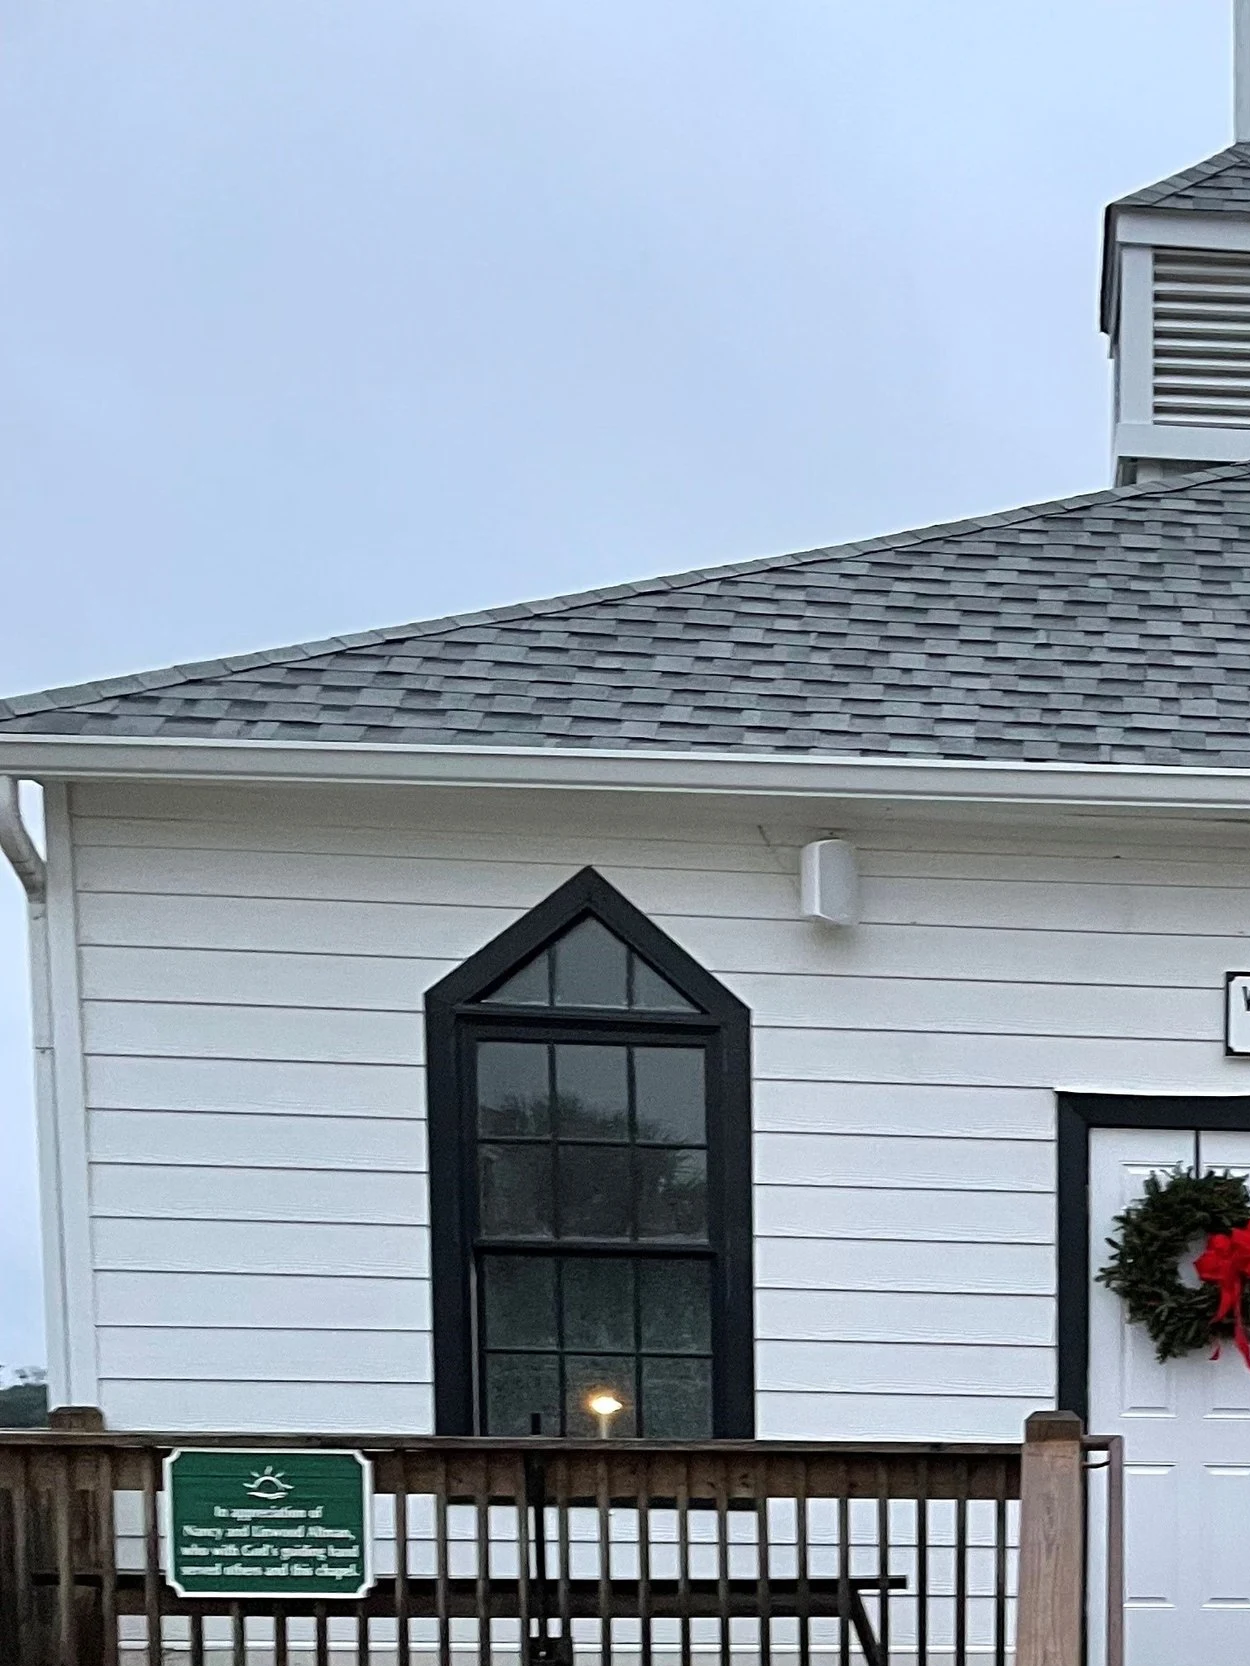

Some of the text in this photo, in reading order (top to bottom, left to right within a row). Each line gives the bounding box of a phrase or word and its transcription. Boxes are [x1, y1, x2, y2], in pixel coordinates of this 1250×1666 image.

[213, 1505, 324, 1521] In appreciation of
[182, 1525, 223, 1540] Nancy
[224, 1525, 250, 1538] and
[179, 1543, 210, 1556] who
[210, 1543, 241, 1556] with
[241, 1543, 279, 1557] God's
[263, 1563, 289, 1576] and
[289, 1563, 314, 1577] this
